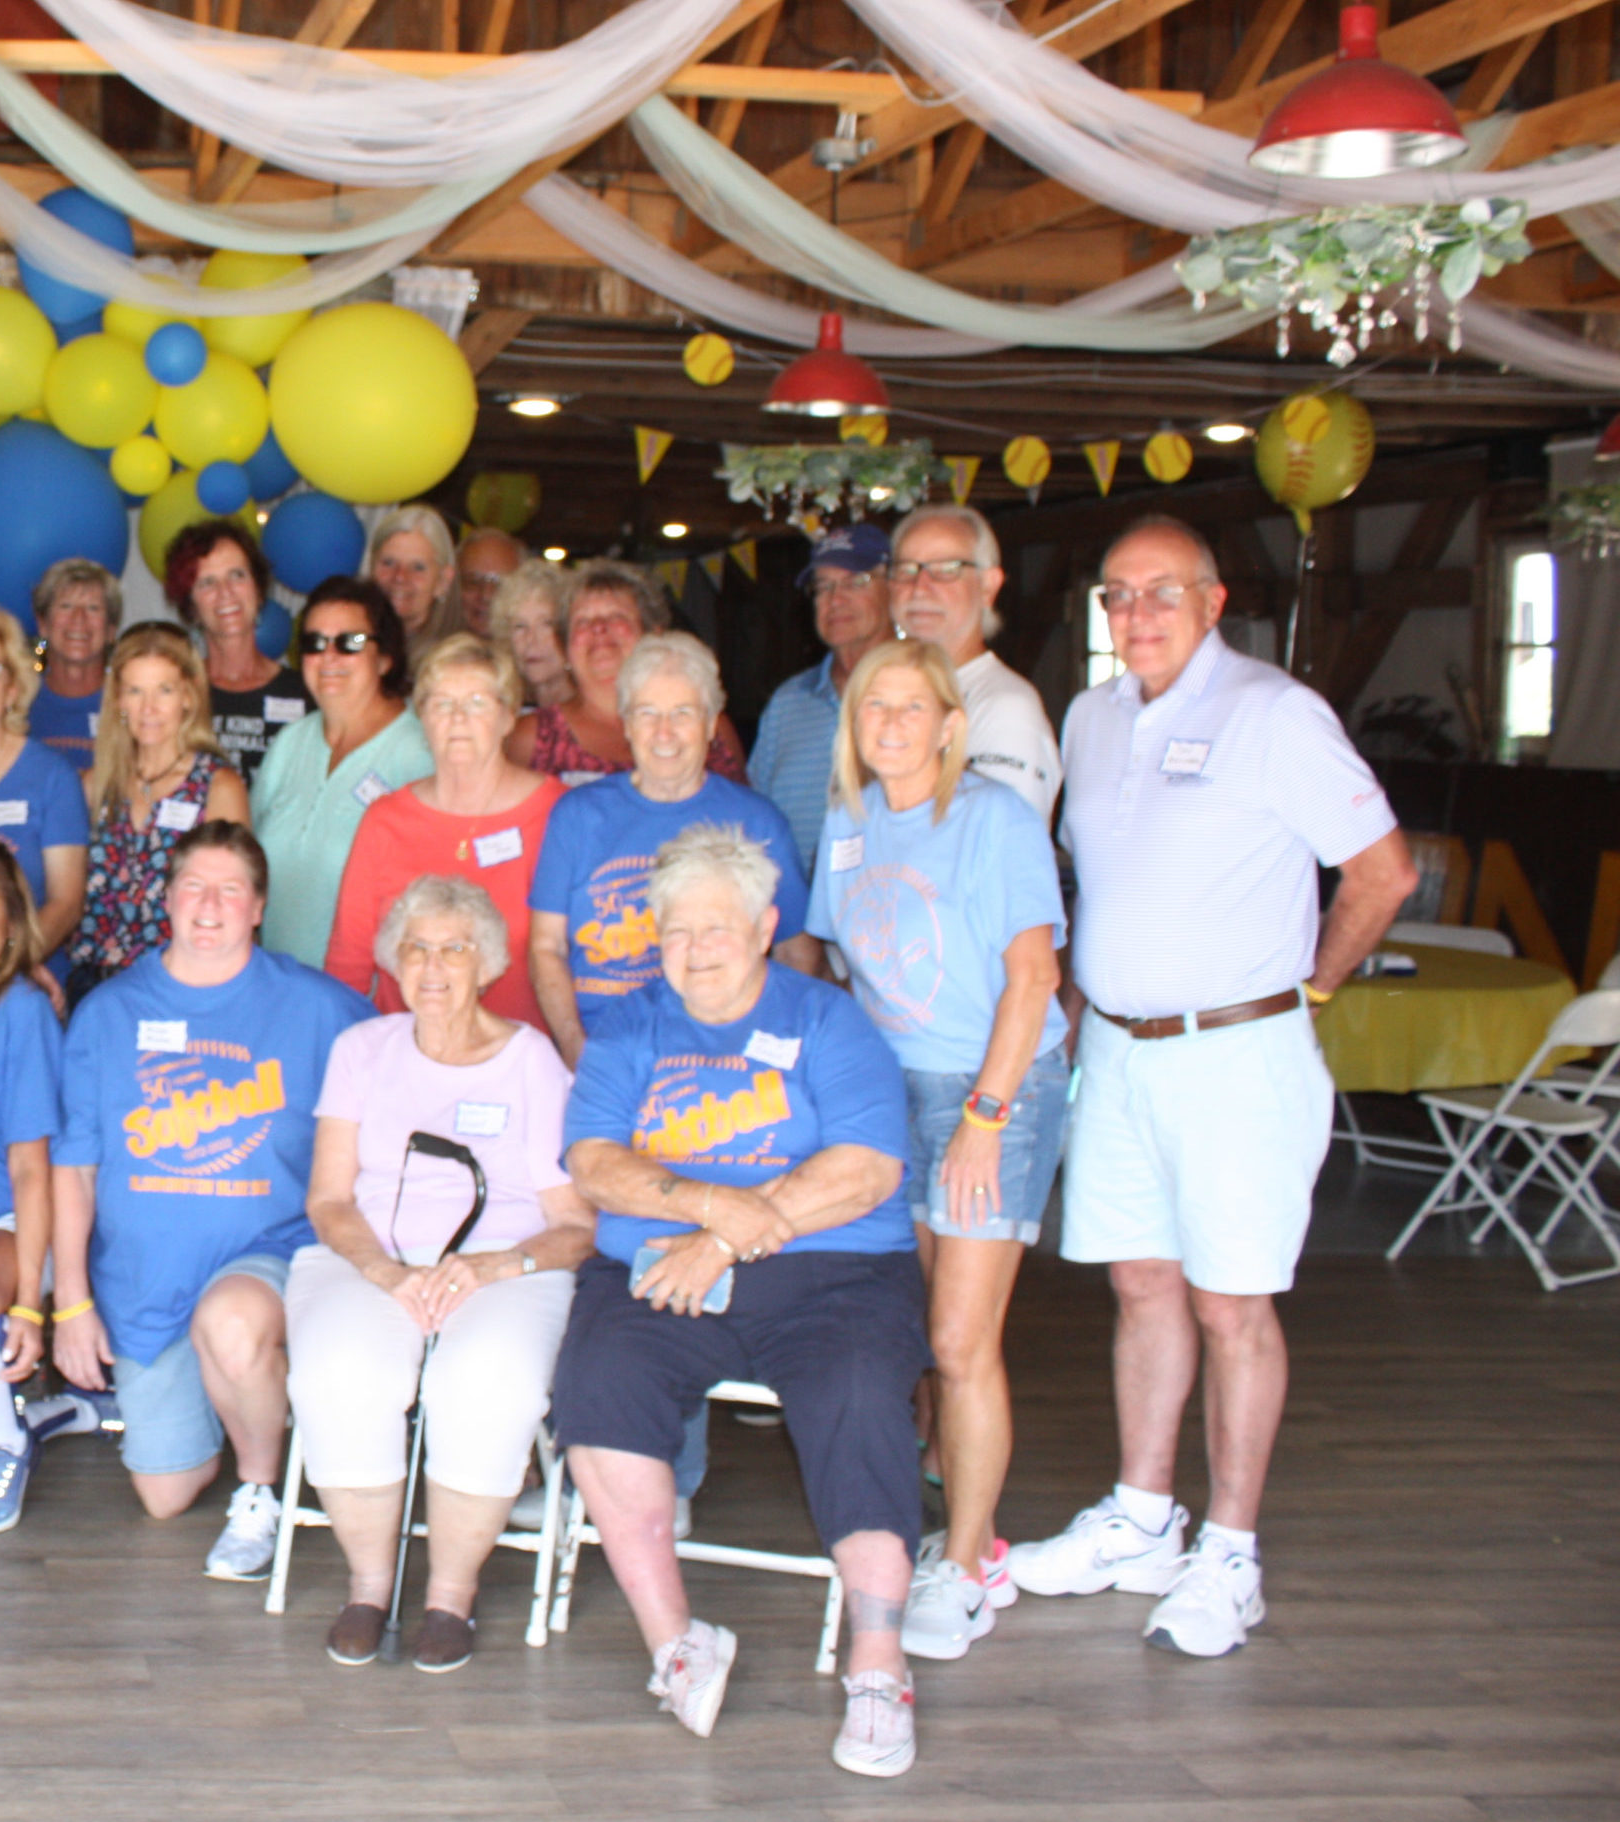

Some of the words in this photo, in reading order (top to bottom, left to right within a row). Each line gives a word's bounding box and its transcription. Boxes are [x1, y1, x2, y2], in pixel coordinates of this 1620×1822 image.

[225, 714, 265, 735] KIND
[140, 1076, 174, 1105] 50
[121, 1058, 286, 1159] Softball
